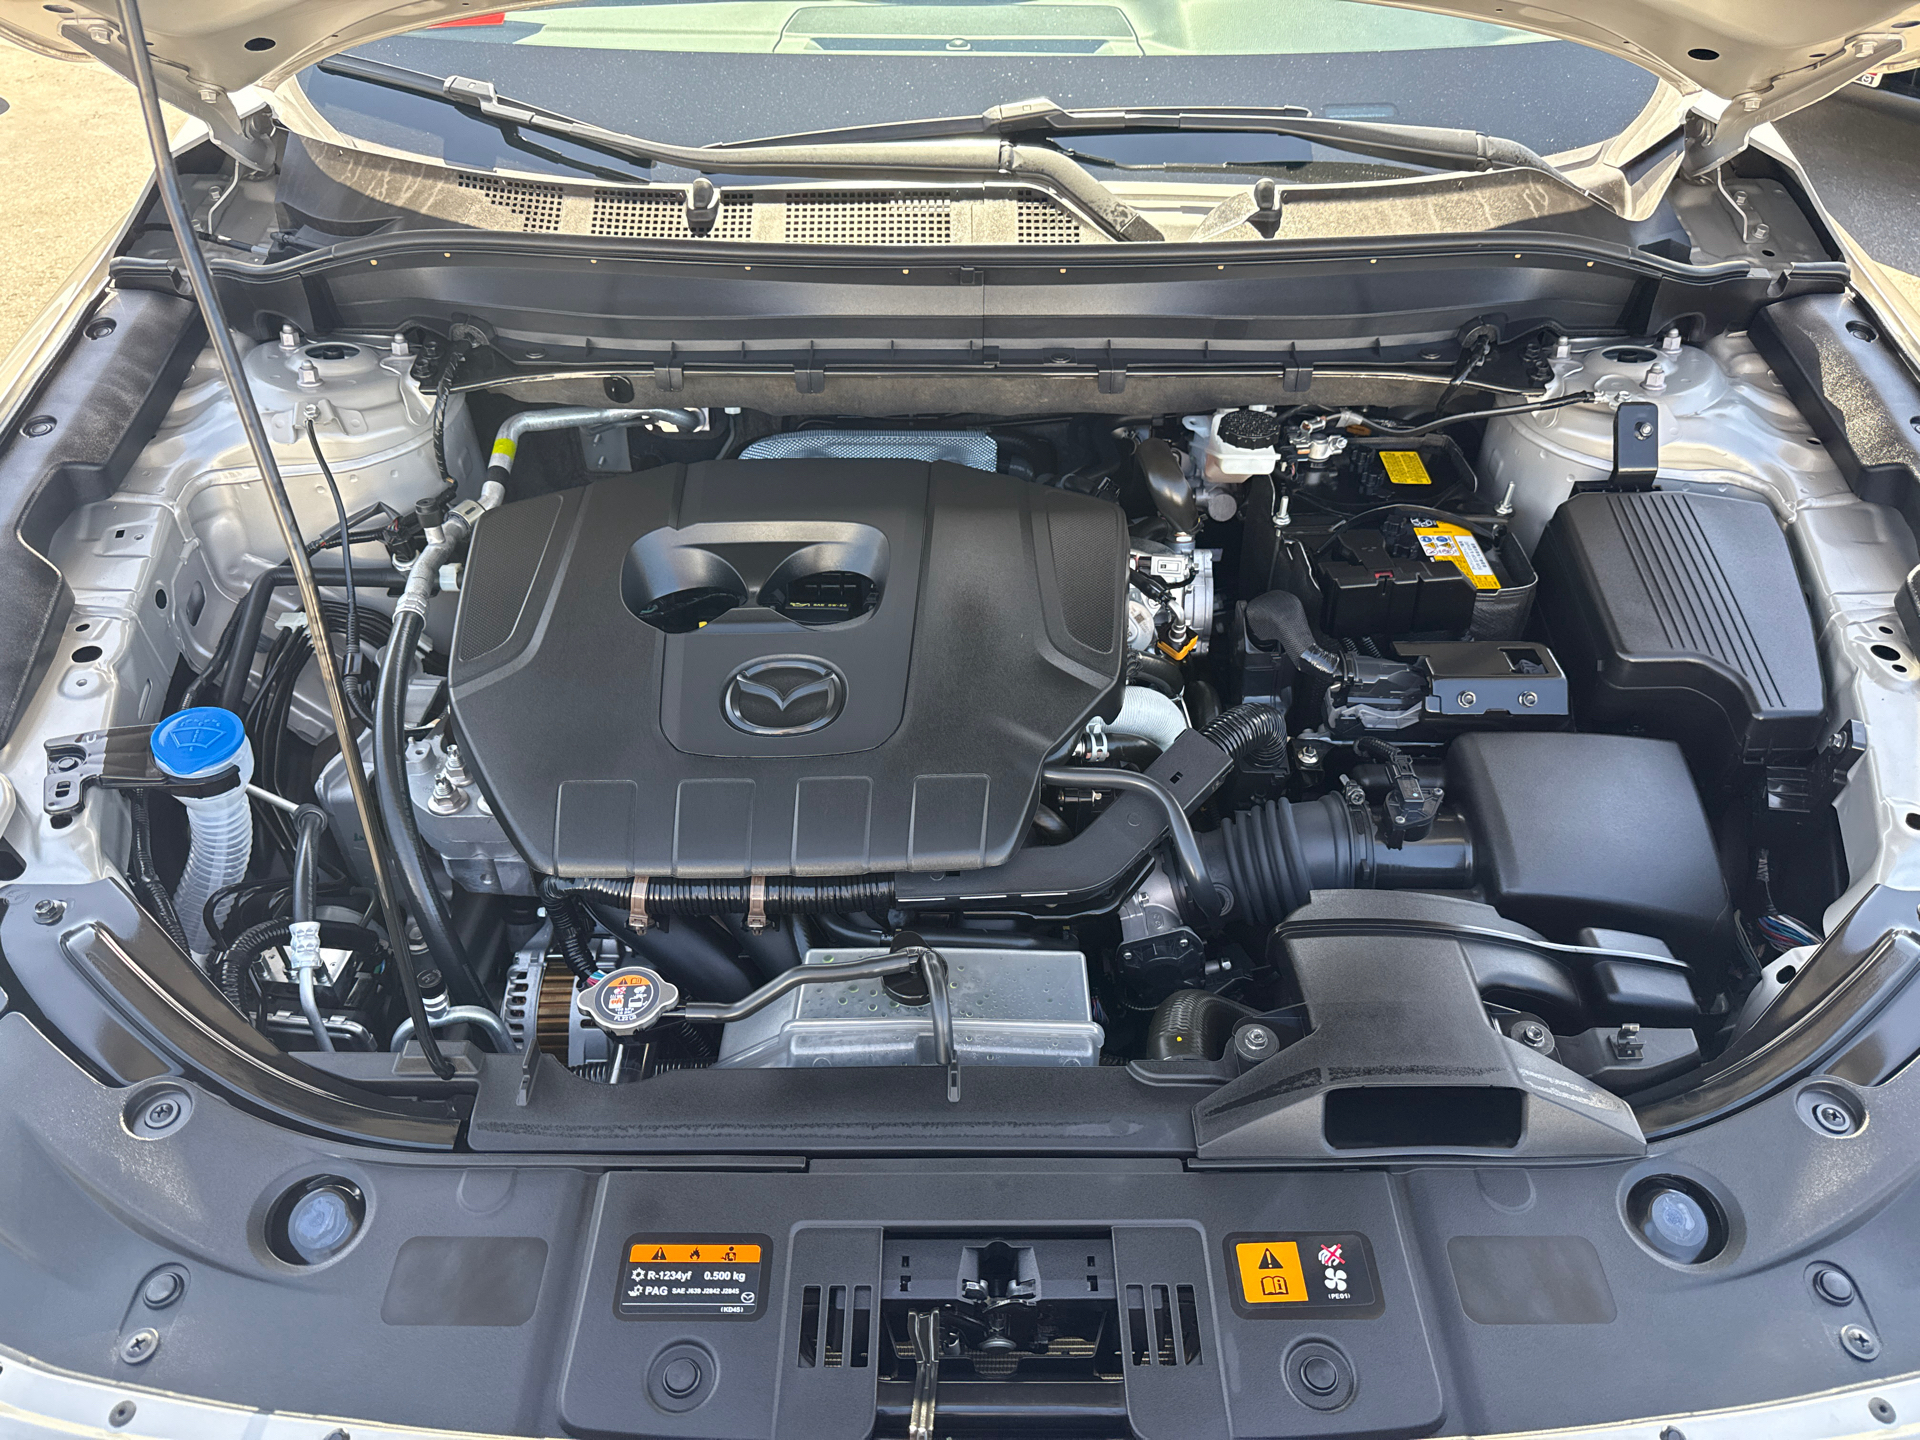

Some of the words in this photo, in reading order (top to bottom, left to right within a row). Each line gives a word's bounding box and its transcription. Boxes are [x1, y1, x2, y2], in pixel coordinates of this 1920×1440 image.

[647, 1271, 693, 1282] R-1234yf
[703, 1271, 731, 1280] 0.500
[732, 1271, 746, 1282] kg
[644, 1286, 669, 1296] PAG
